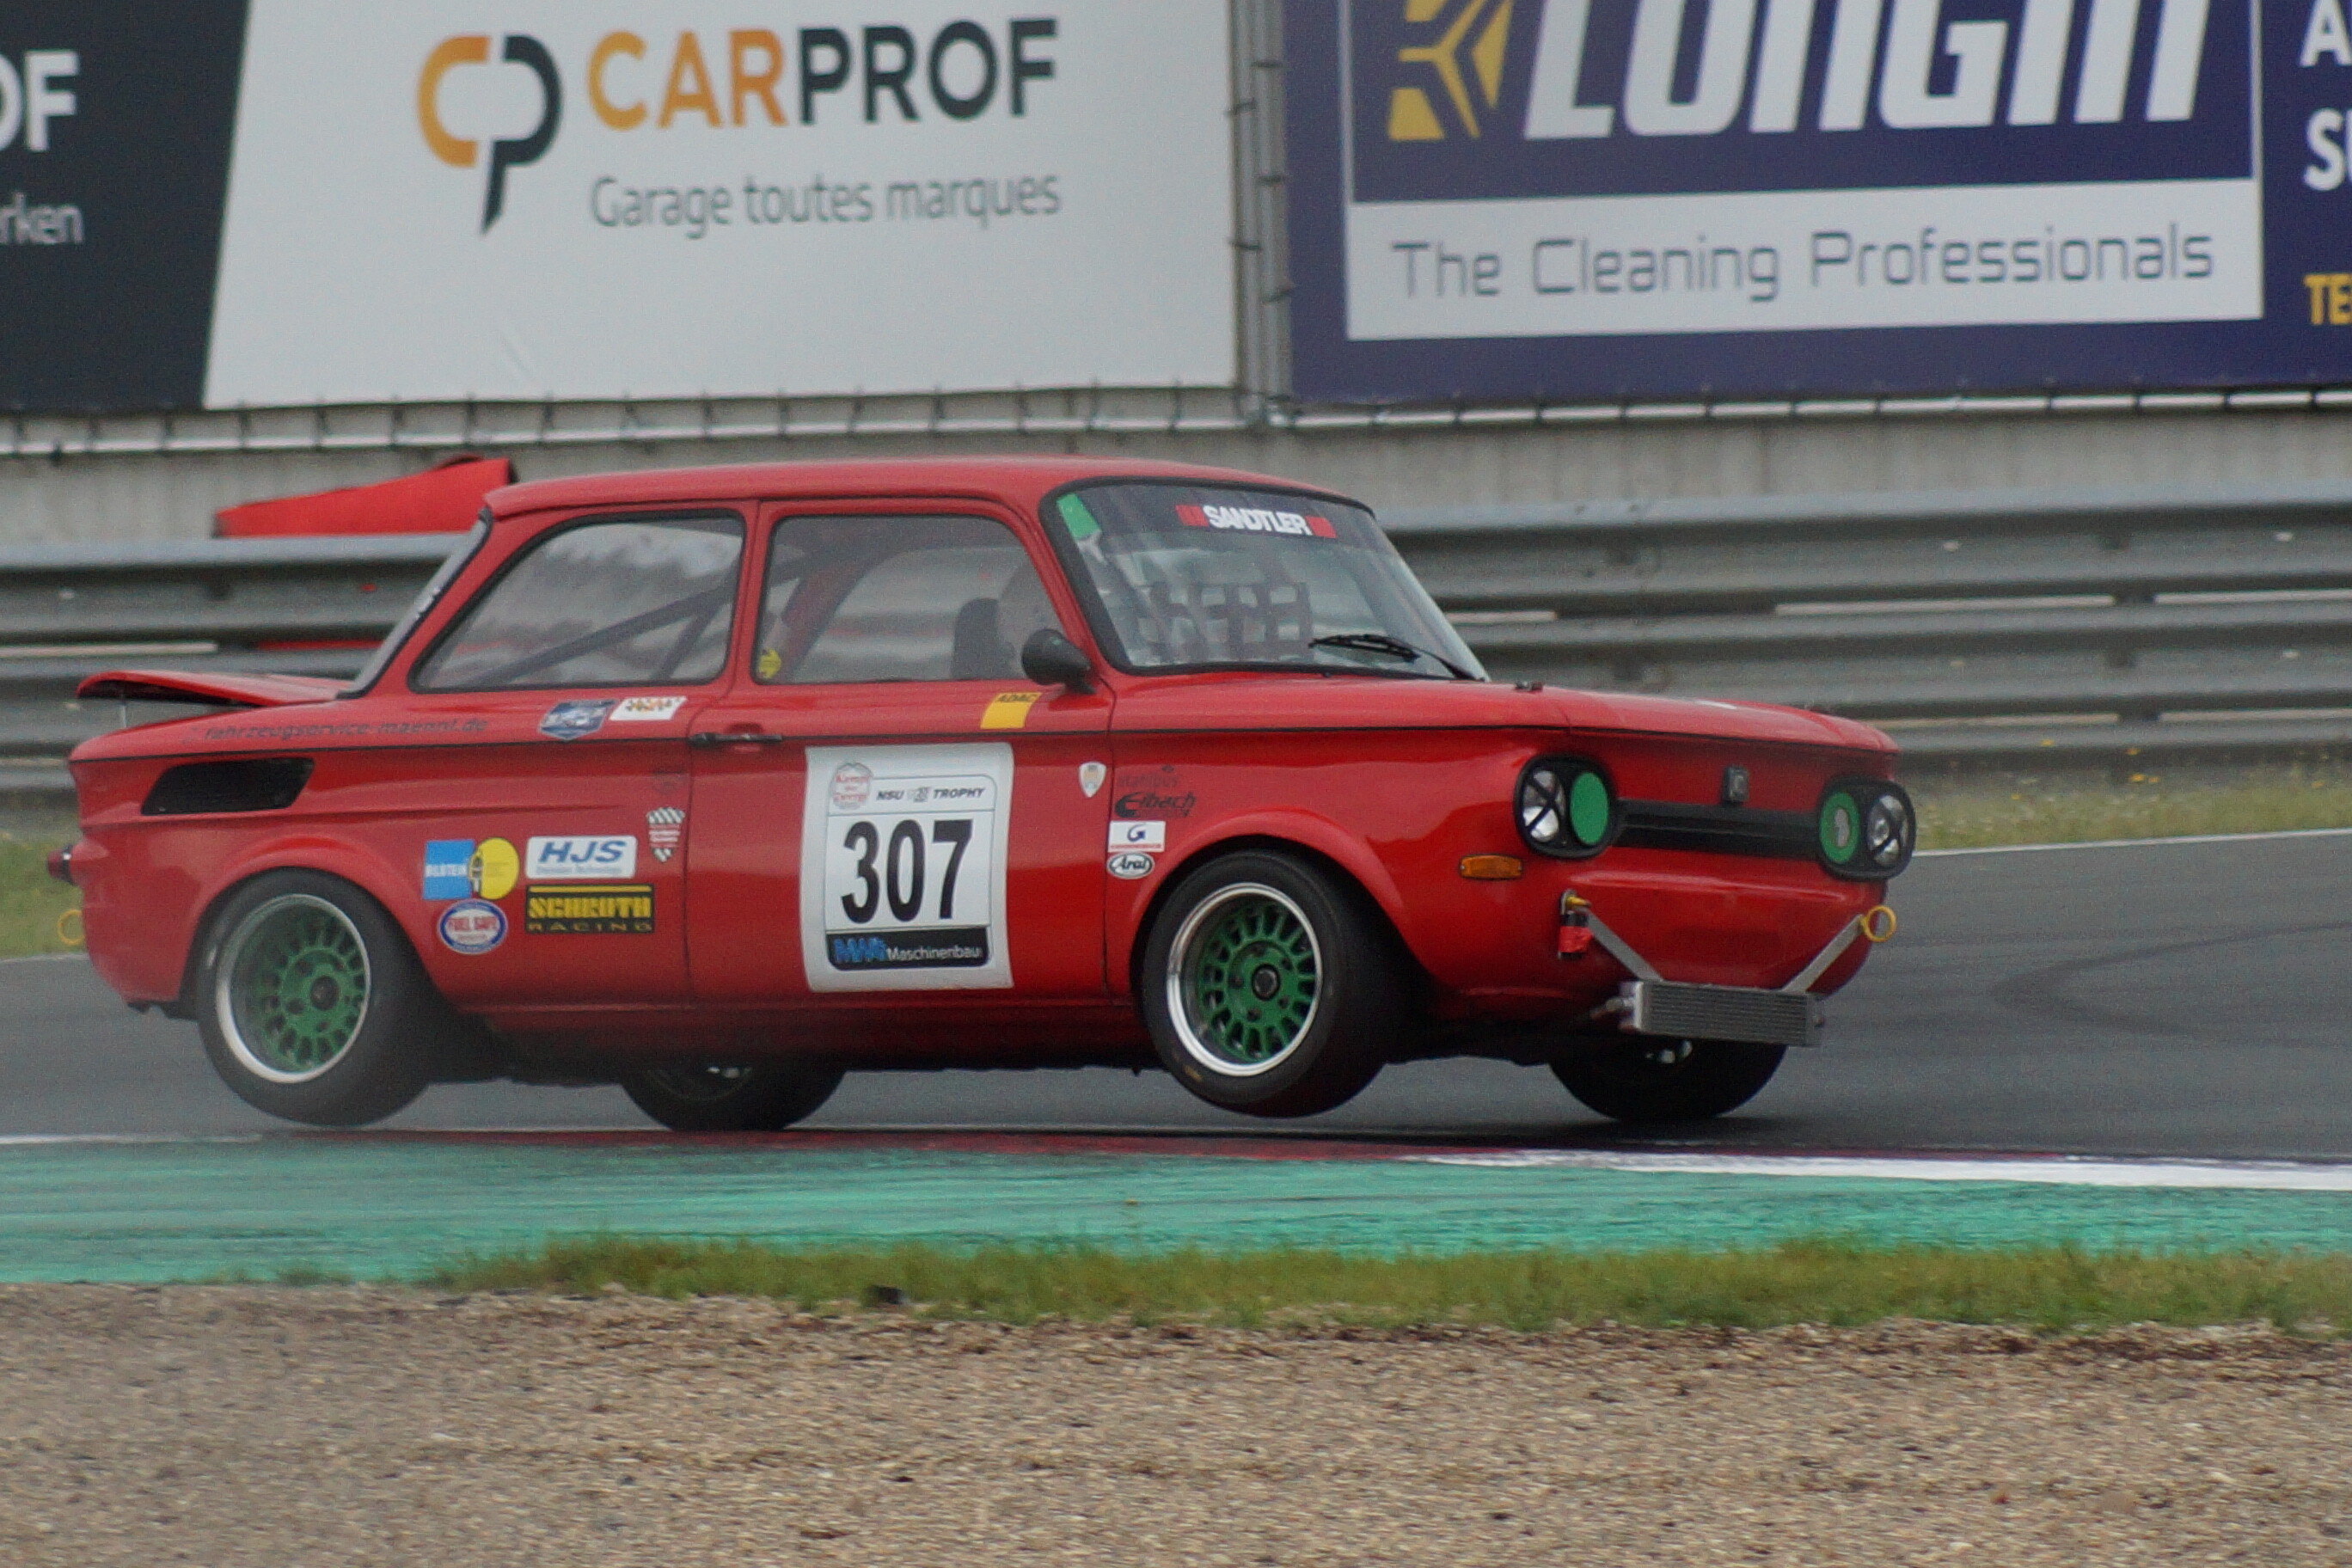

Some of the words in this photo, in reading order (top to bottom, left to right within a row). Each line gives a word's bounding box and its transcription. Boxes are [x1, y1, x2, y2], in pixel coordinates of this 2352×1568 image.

[0, 50, 78, 152] F
[586, 18, 1057, 132] CARPROF
[2304, 107, 2352, 191] S
[591, 175, 731, 240] Garage
[744, 175, 872, 224] toutes
[886, 175, 1062, 229] marques
[1391, 239, 1500, 297] The
[1534, 234, 1779, 303] Cleaning
[1811, 221, 2213, 286] Professionals
[1204, 505, 1312, 536] SANDTLER
[933, 787, 985, 799] TROPHY
[538, 840, 627, 863] HJS
[841, 818, 973, 923] 307
[885, 945, 983, 961] Maschinenbau
